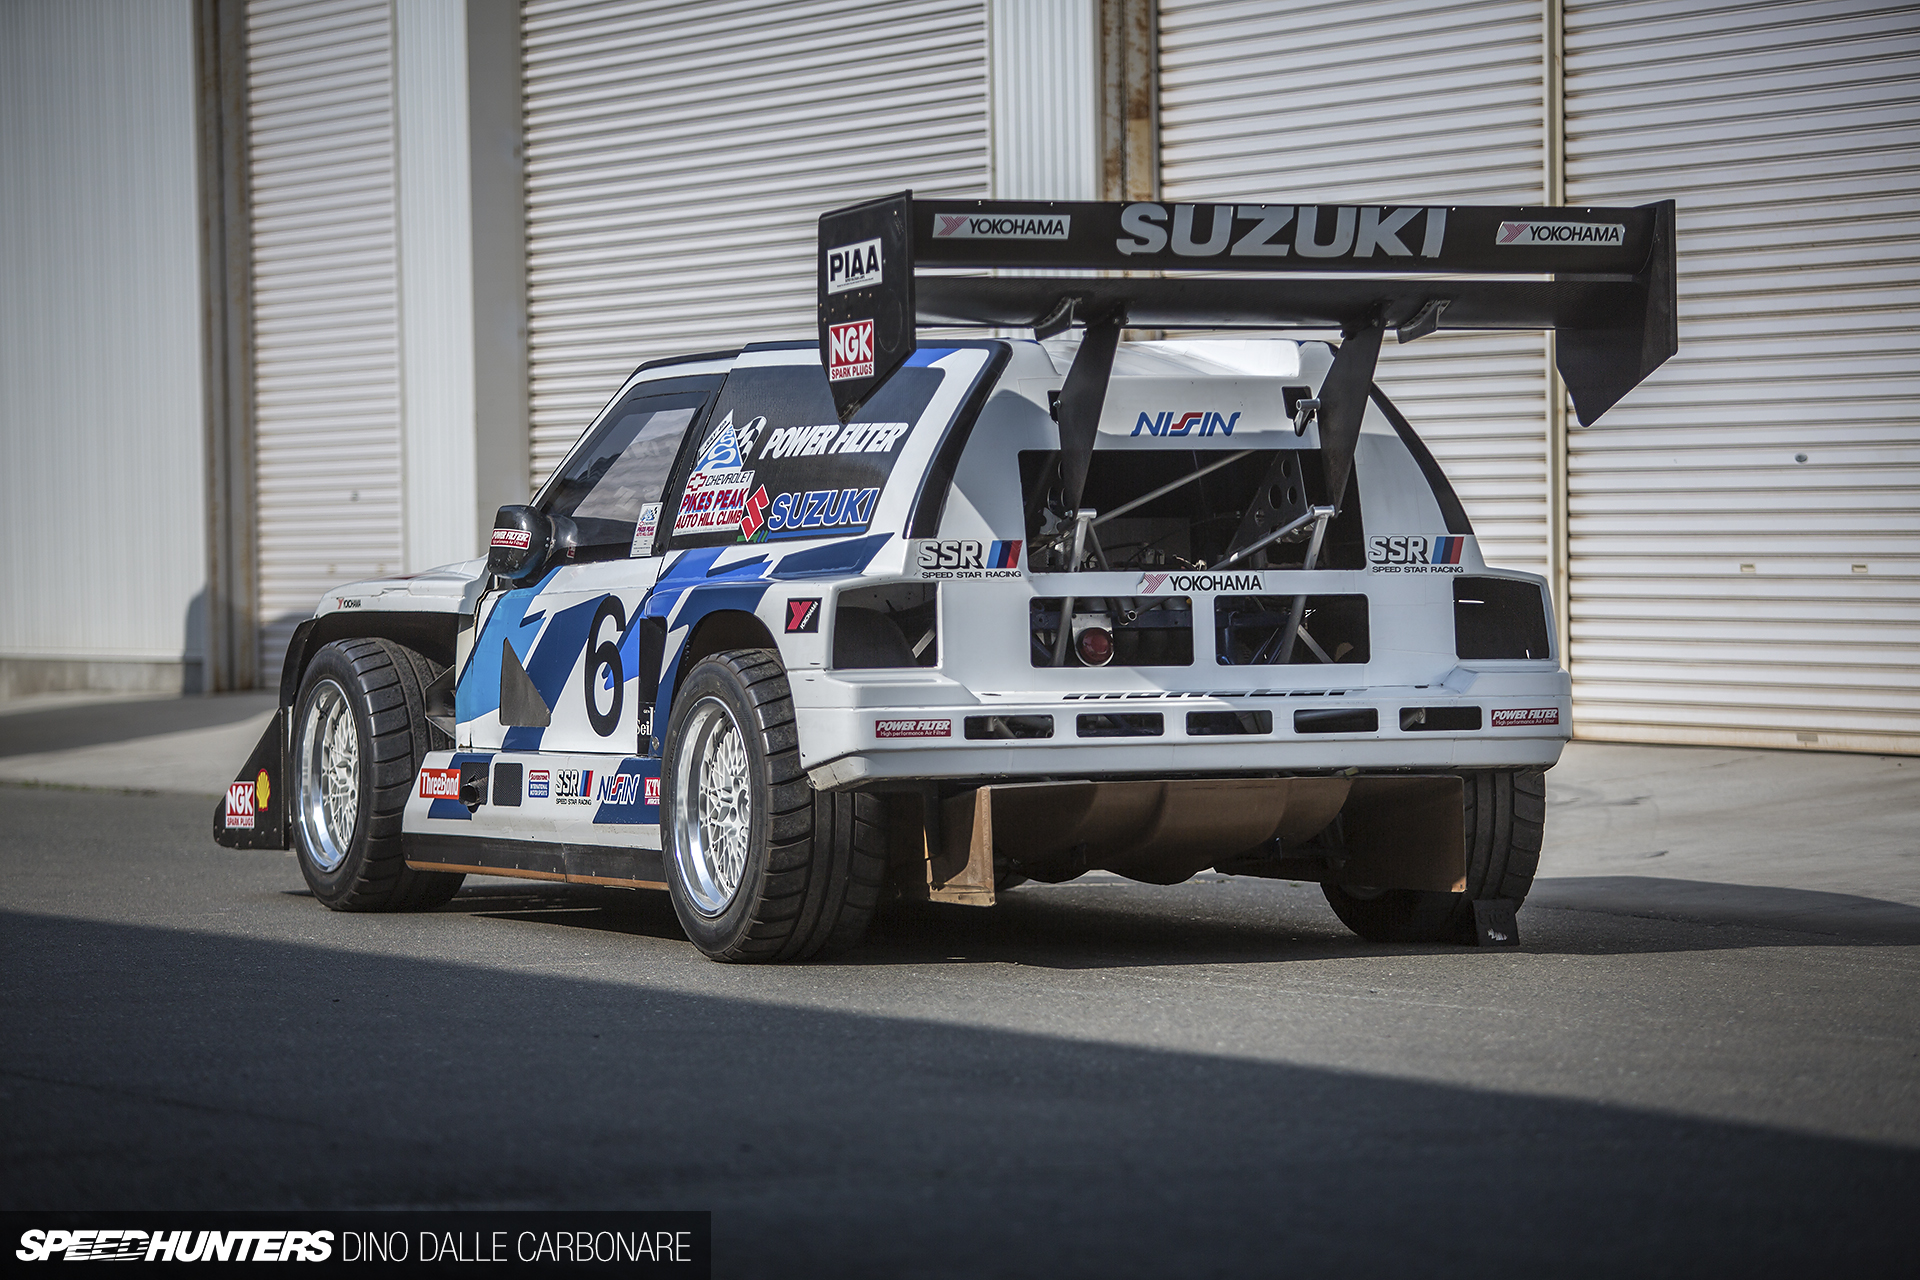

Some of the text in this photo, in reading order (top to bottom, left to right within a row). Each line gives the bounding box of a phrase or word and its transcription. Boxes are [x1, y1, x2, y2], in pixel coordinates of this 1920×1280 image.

[969, 218, 1065, 235] YOKOHAMA
[1116, 203, 1447, 258] SUZUKI
[1530, 225, 1620, 242] YOKOHAMA
[829, 245, 880, 282] PIAA
[830, 324, 872, 365] NGK
[831, 364, 873, 380] SPARK PLUGS
[758, 424, 840, 460] POWER
[828, 422, 909, 454] FILTER
[705, 471, 754, 487] CHEVROLET
[678, 490, 715, 514] PIKES
[712, 487, 749, 511] PEAK
[768, 487, 880, 531] SUZUKI
[674, 509, 743, 530] AUTO HILL CLIMB
[506, 531, 529, 542] FILTER
[917, 540, 985, 569] SSR
[1368, 536, 1430, 565] SSR
[921, 570, 1022, 579] SPEED STAR RACING
[1169, 575, 1263, 592] YOKOHAMA
[584, 594, 627, 738] 6
[876, 720, 951, 731] POWER FILTER
[1492, 709, 1558, 720] POWER FILTER
[421, 771, 460, 796] ThreeBond
[555, 769, 580, 797] SSR
[227, 784, 253, 815] NGK
